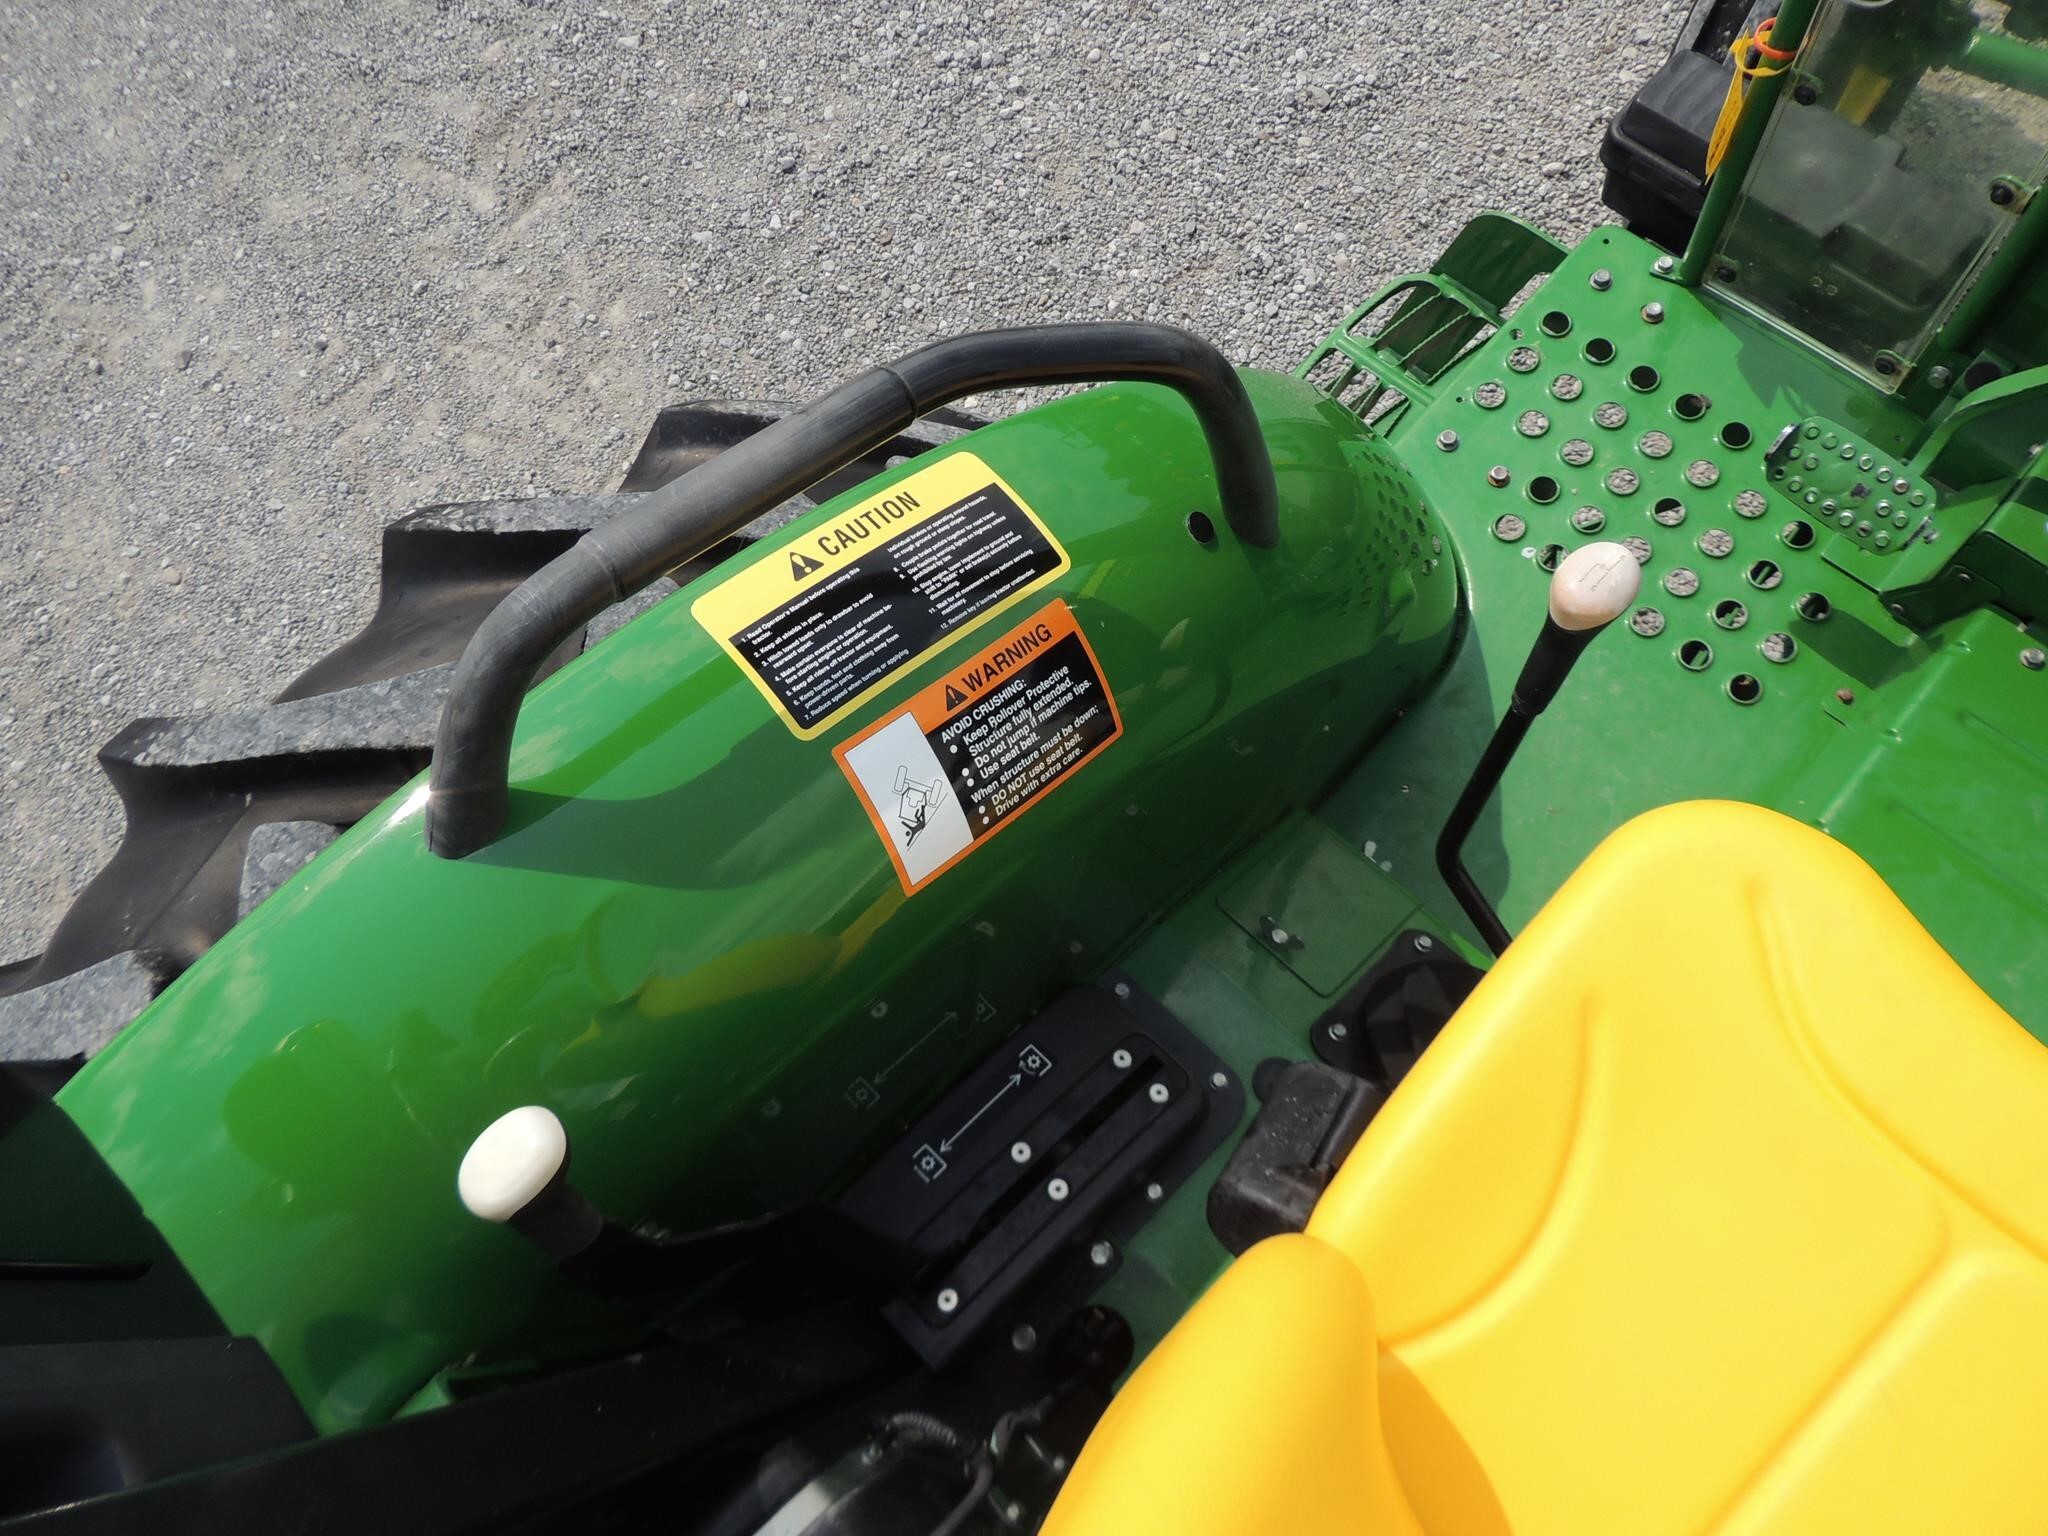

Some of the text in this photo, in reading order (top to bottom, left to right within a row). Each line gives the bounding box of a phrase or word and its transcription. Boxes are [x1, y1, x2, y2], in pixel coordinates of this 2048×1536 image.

[818, 491, 920, 556] CAUTION
[751, 631, 773, 645] tractor.
[759, 642, 776, 654] Keep
[782, 625, 802, 640] shields
[807, 612, 824, 624] place.
[767, 651, 783, 663] Hitch
[782, 639, 800, 653] towed
[798, 630, 815, 642] loads
[814, 623, 827, 633] only
[832, 606, 853, 621] drawbar
[858, 593, 874, 605] avoid
[773, 640, 814, 669] rearward upset.
[785, 674, 798, 684] fore
[797, 660, 819, 677] starting
[818, 649, 837, 663] engine
[842, 629, 868, 647] operation.
[791, 680, 807, 692] Keep
[813, 665, 830, 678] riders
[837, 648, 855, 662] tractor
[865, 624, 893, 644] equipment.
[961, 624, 1052, 692] WARNING
[799, 690, 815, 702] Keep
[813, 679, 833, 692] hands,
[853, 650, 875, 666] clothing
[873, 641, 888, 652] away
[886, 633, 899, 644] from
[805, 673, 854, 709] power-driven parts.
[810, 700, 832, 716] Reduce
[831, 688, 848, 703] speed
[847, 679, 863, 691] when
[861, 667, 882, 682] turning
[887, 649, 909, 665] applying
[942, 680, 1026, 743] AVOID CRUSHING:
[963, 666, 1068, 745] Keep Rollover Protective
[969, 677, 1073, 756] Structure fully extended.
[974, 680, 1092, 768] Do not jump if machine tips.
[971, 705, 1099, 803] When structure must be down;
[980, 732, 1040, 779] Use seat belt.
[991, 733, 1083, 806] DO NOT use seat belt.
[995, 748, 1083, 816] Drive with extra care.
